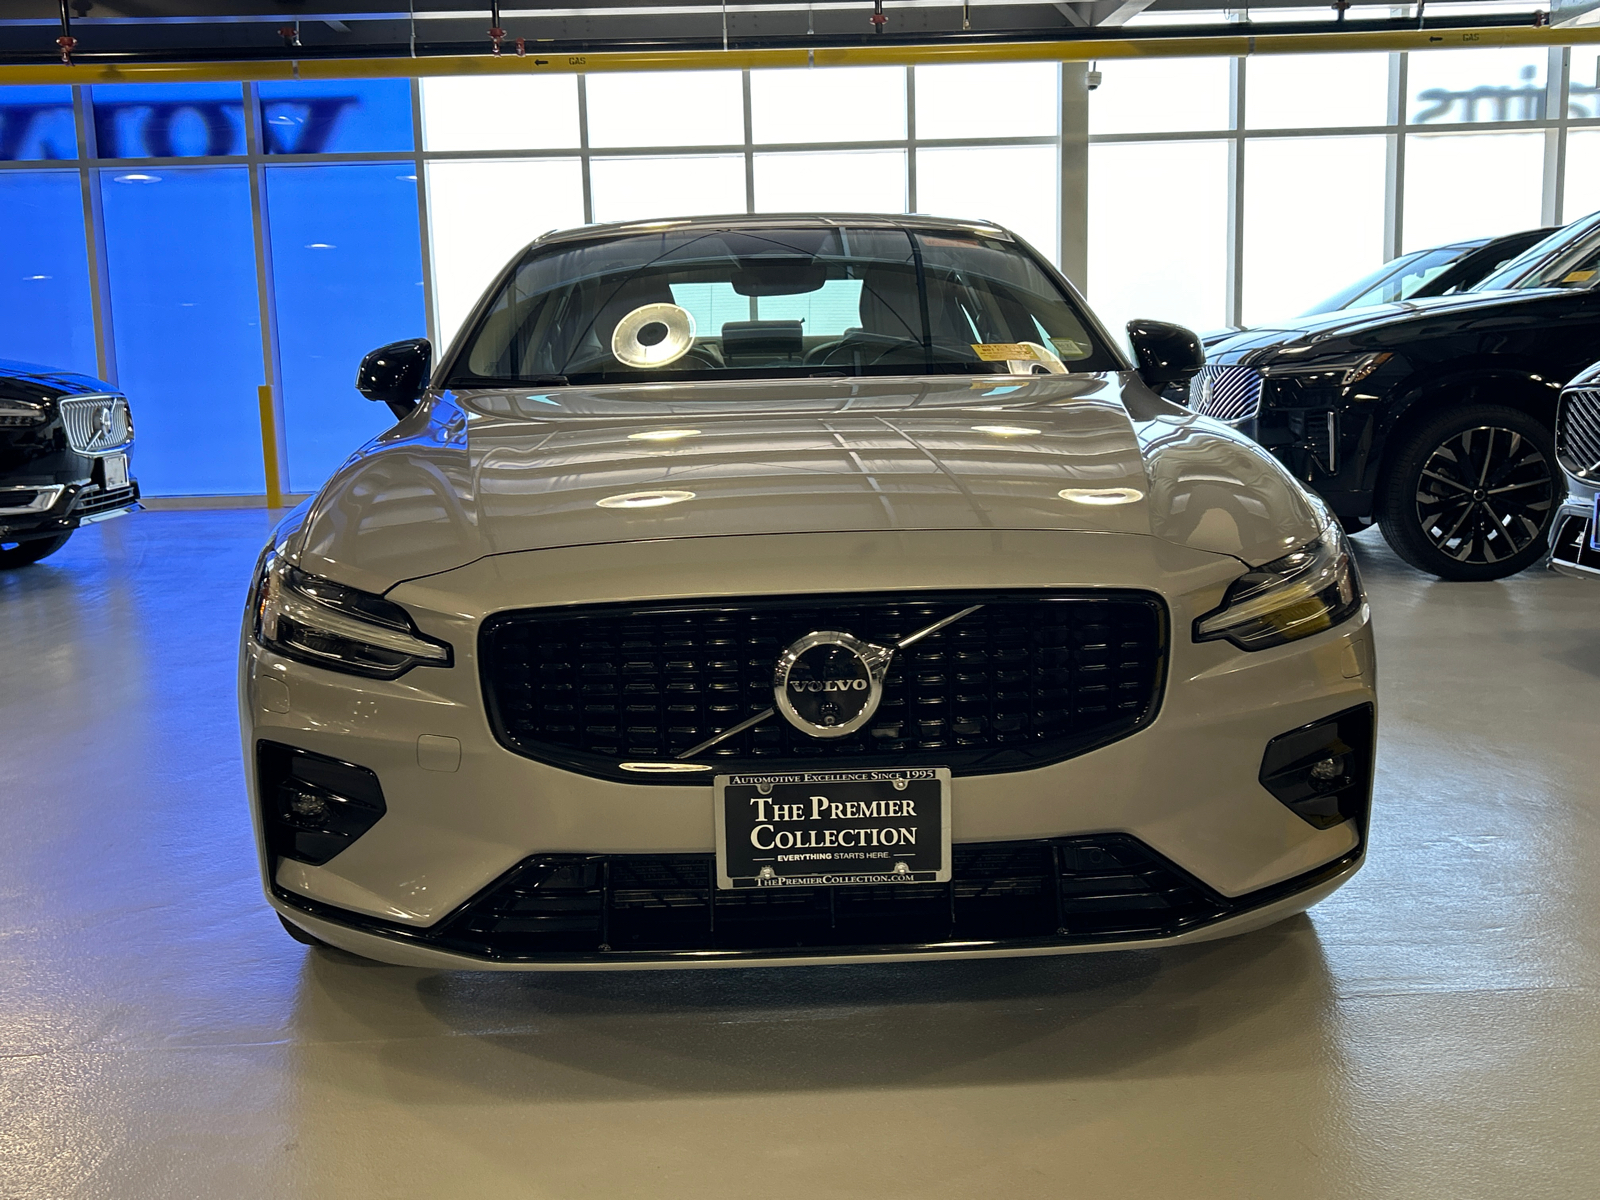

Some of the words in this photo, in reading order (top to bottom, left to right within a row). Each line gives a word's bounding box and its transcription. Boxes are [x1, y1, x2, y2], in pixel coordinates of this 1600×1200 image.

[1462, 33, 1480, 42] GAS
[568, 57, 586, 65] GAS
[789, 679, 868, 692] VOLVO
[906, 769, 934, 779] 1995
[750, 797, 805, 822] THE
[809, 796, 917, 820] PREMIER
[750, 824, 918, 850] COLLECTION
[777, 853, 832, 862] EVERYTHING
[834, 852, 865, 860] STARTS
[866, 851, 891, 859] HERE.
